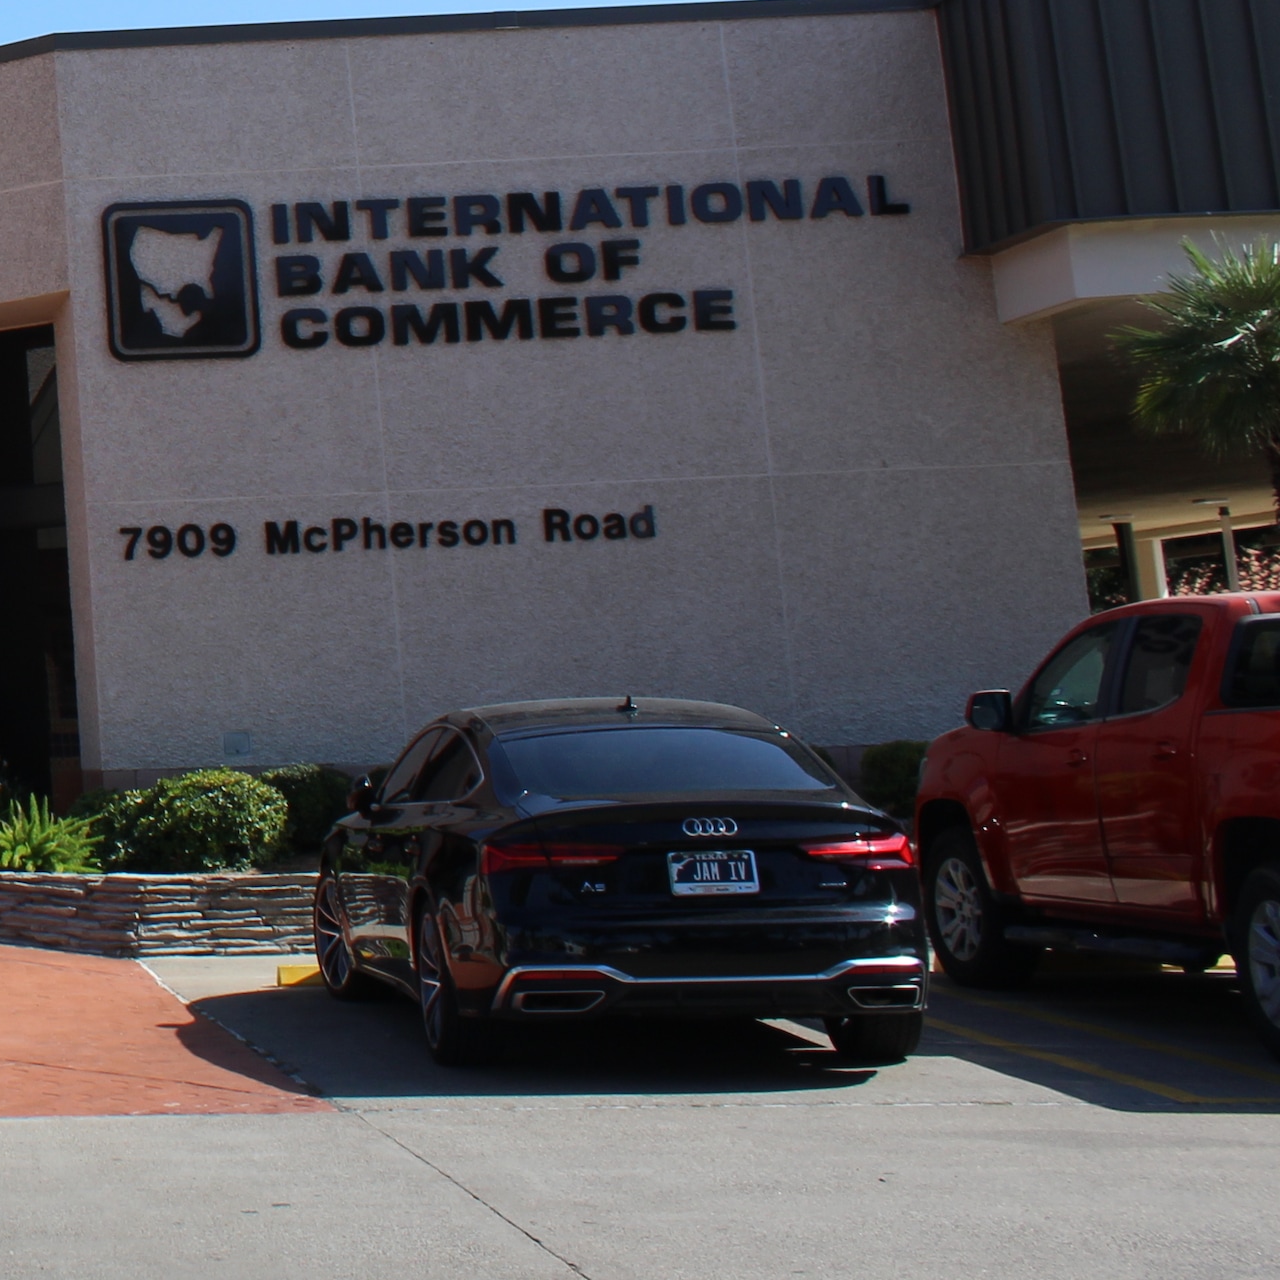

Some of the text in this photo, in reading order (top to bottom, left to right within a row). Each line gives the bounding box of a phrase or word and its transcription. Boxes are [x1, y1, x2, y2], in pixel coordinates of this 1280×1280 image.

[271, 175, 911, 245] INTERNATIONAL
[276, 238, 640, 298] BANK OF
[281, 289, 737, 350] COMMERCE
[119, 504, 657, 561] 7909 McPherson Road
[694, 853, 729, 861] TEXAS
[727, 861, 746, 880] IV
